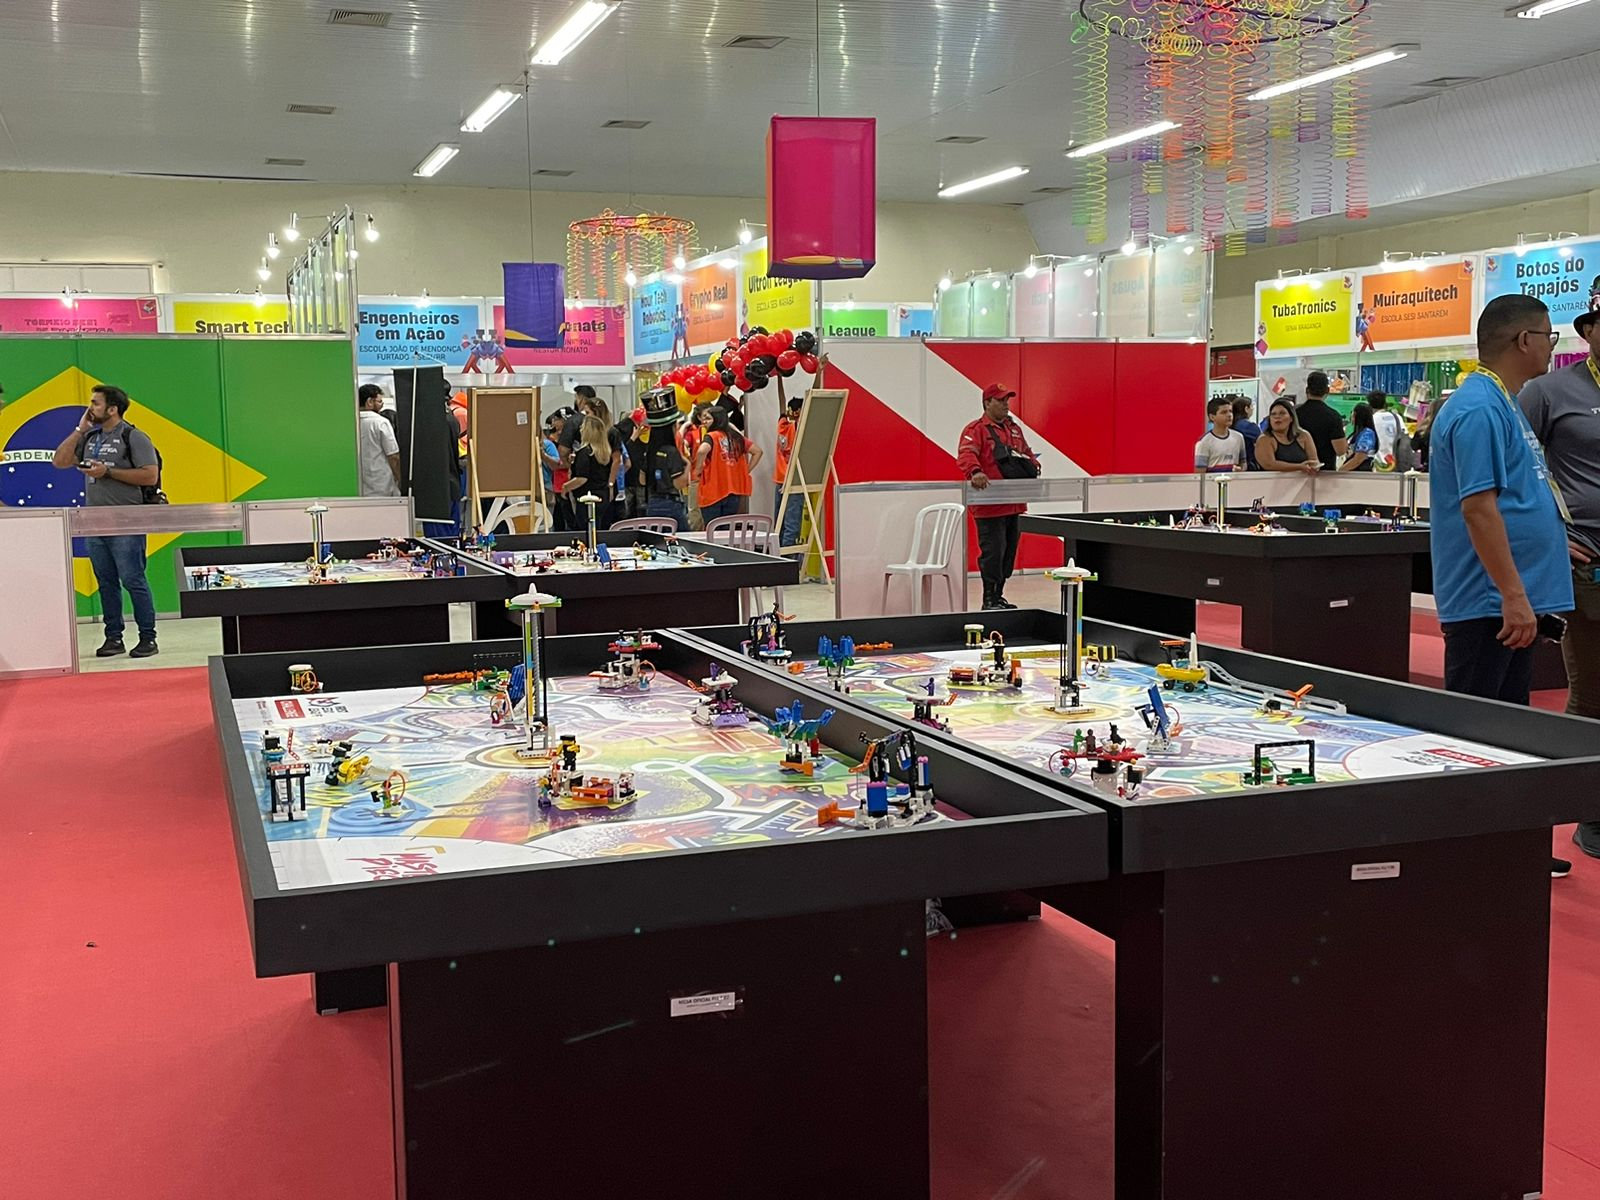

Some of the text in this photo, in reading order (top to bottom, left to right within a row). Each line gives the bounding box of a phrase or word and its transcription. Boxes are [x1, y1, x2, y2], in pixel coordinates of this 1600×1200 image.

[1516, 256, 1584, 278] Botos do
[713, 282, 729, 301] Real
[1520, 275, 1579, 298] Tapajós
[1373, 284, 1458, 308] Muiraquitech
[1272, 298, 1337, 318] TubaTronics
[359, 311, 460, 327] Engenheiros
[1381, 313, 1402, 323] ESCOLA
[195, 320, 249, 334] Smart
[375, 327, 446, 343] em Ação
[829, 325, 876, 337] League
[360, 345, 388, 353] ESCOLA
[377, 353, 410, 361] FURTADO
